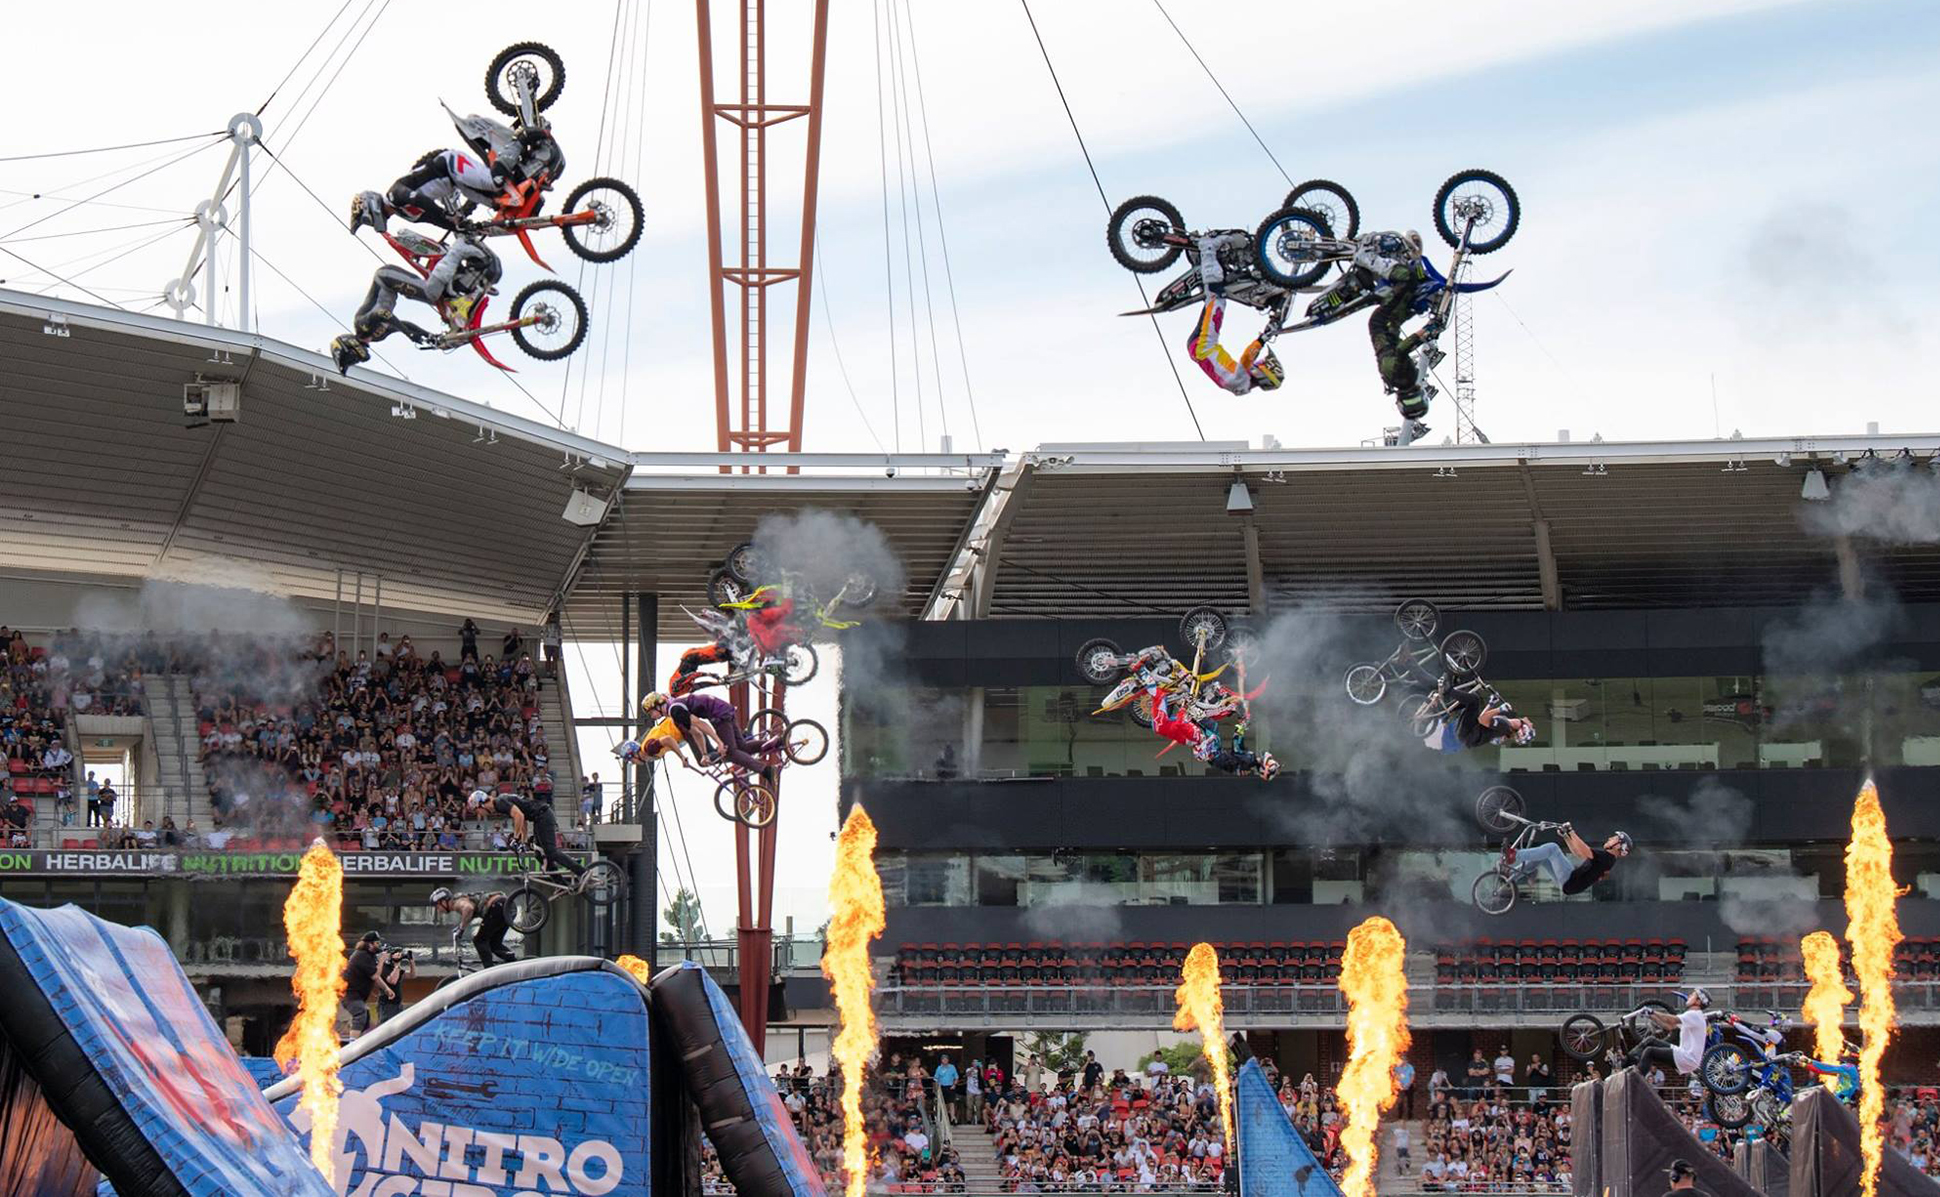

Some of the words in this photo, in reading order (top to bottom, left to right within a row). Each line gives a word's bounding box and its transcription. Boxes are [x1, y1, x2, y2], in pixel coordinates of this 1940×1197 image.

[434, 1024, 498, 1049] KEEP
[501, 1037, 529, 1061] IT
[532, 1042, 583, 1071] WIDE
[586, 1060, 640, 1086] OPEN
[383, 1111, 624, 1196] NITRO
